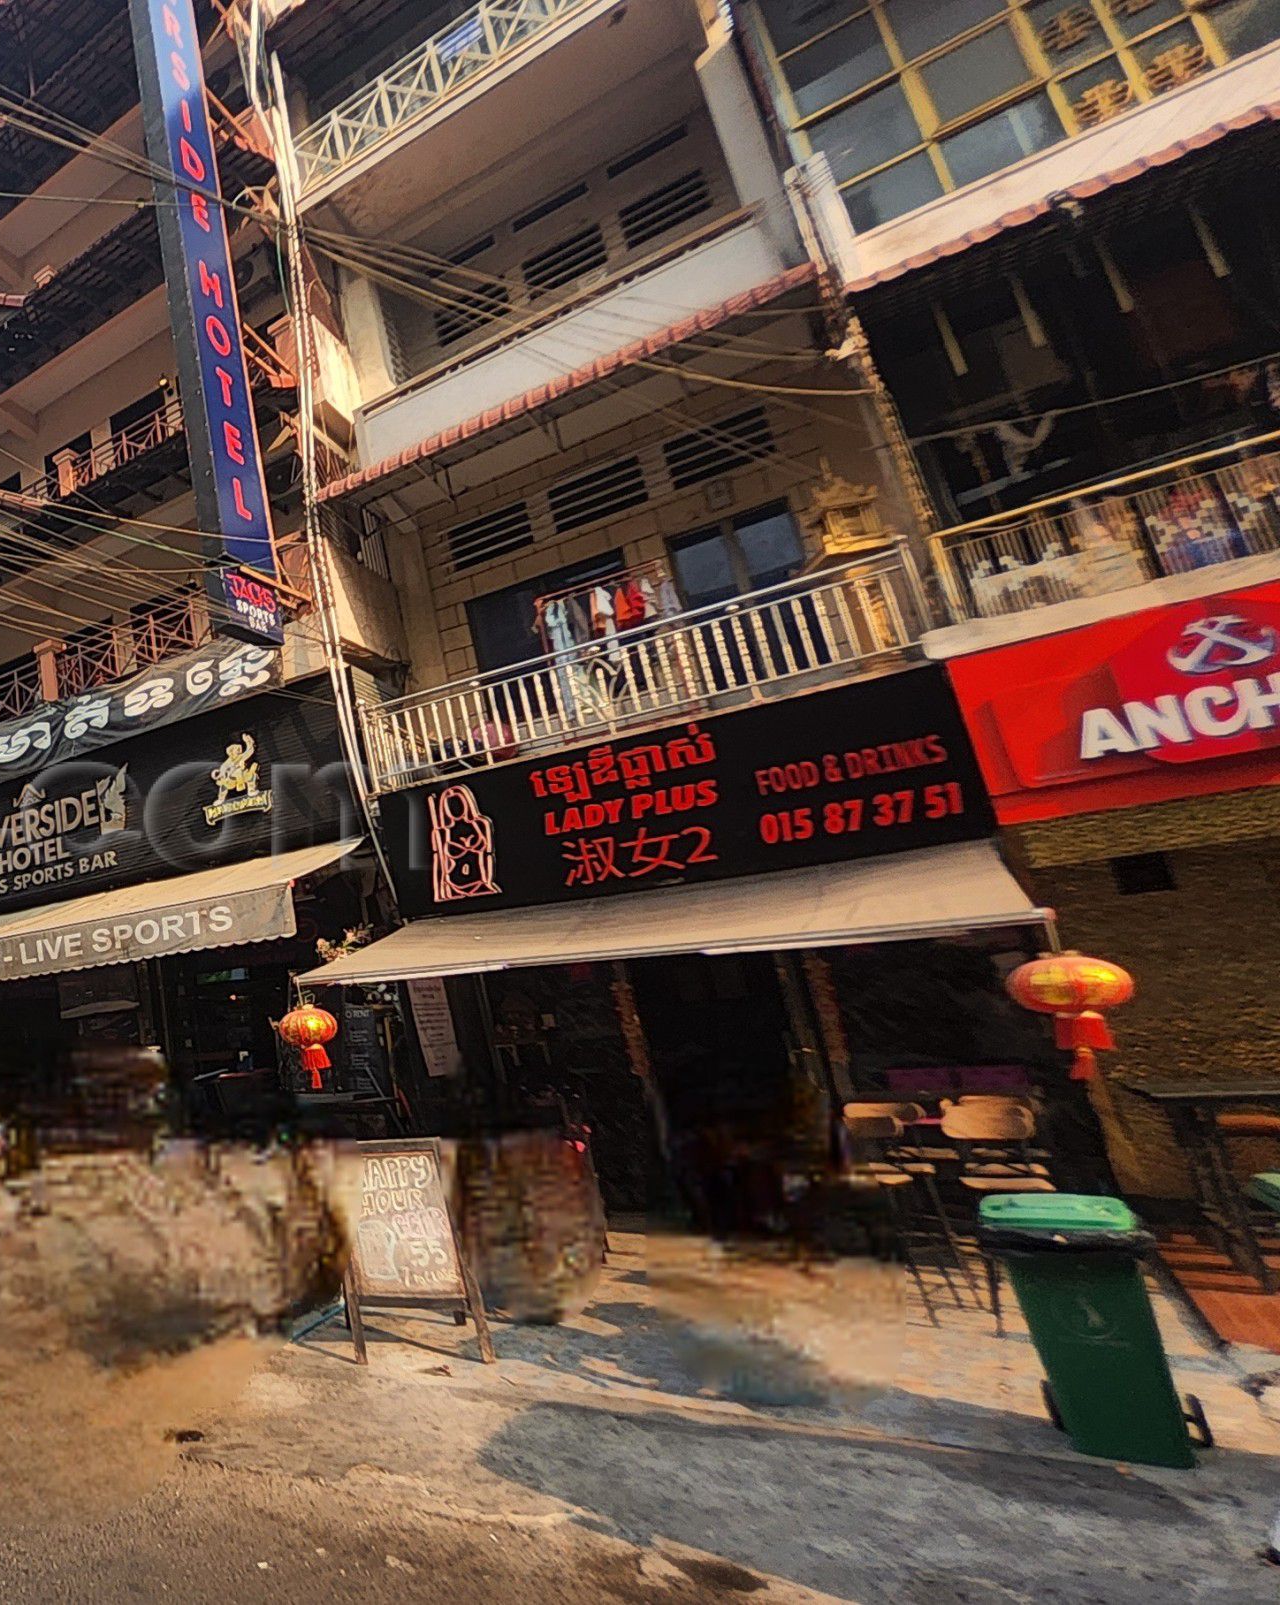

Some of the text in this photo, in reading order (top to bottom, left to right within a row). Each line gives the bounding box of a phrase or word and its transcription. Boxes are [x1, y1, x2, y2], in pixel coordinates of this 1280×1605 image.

[162, 0, 253, 522] RSIDE HOTEL
[235, 600, 276, 627] SPORTS
[248, 615, 269, 634] BAR
[754, 734, 948, 796] FOOD & DRINKS
[544, 778, 719, 837] LADY PLUS
[759, 780, 965, 845] 015 87 37 51
[12, 863, 75, 892] SPORTS
[78, 850, 119, 875] BAR
[560, 825, 720, 887] 淑女2
[19, 932, 83, 966] LIVE
[91, 905, 234, 955] SPORTS
